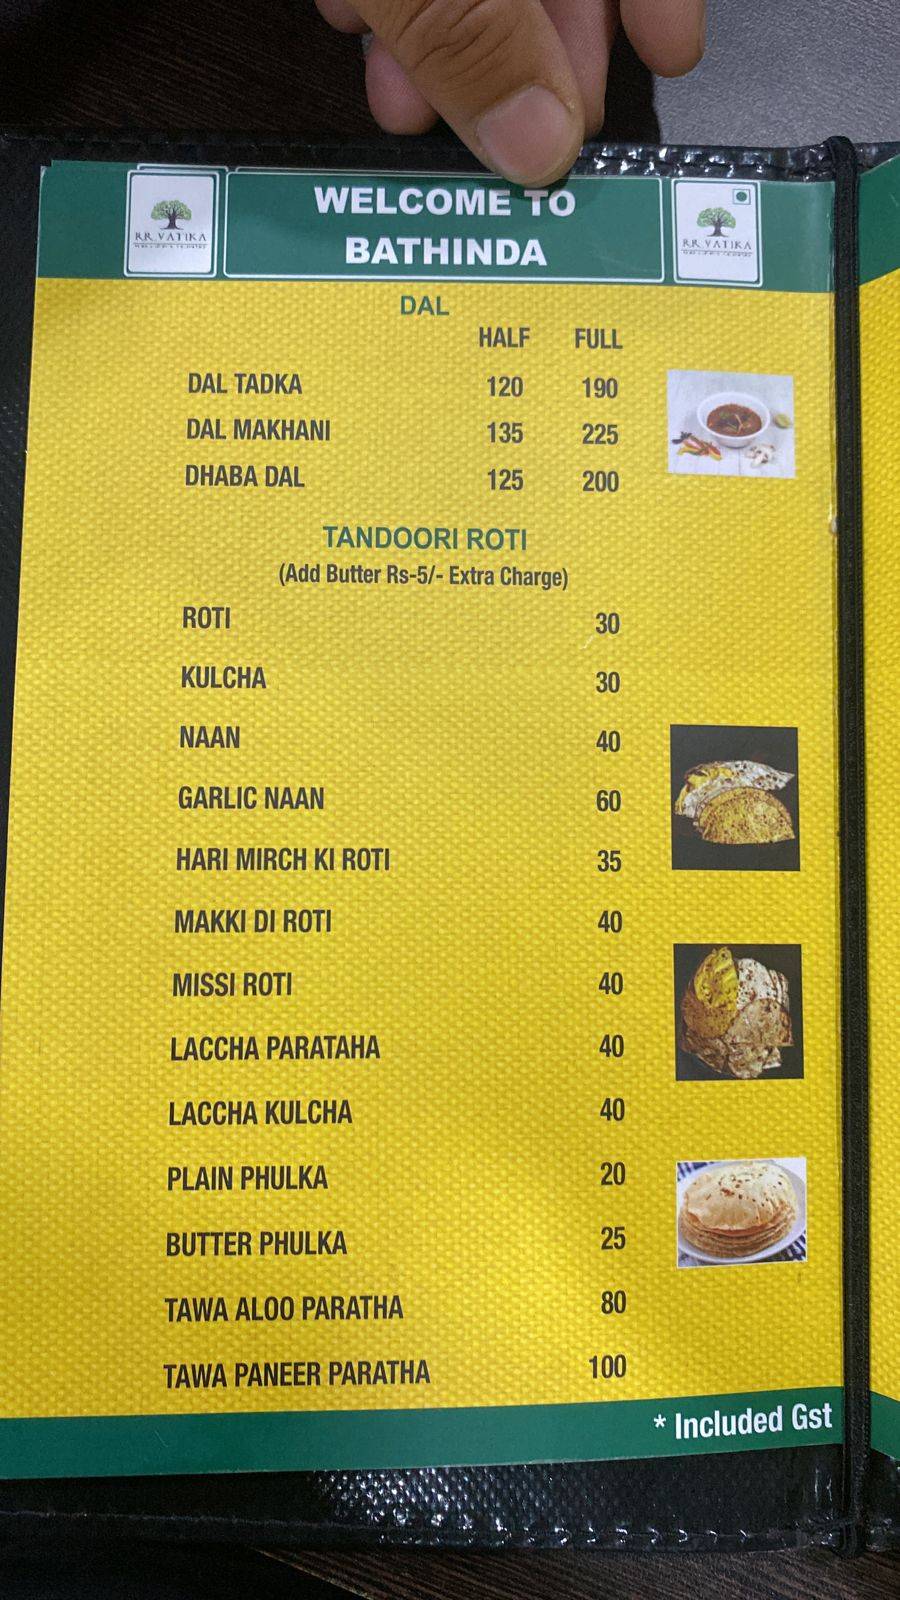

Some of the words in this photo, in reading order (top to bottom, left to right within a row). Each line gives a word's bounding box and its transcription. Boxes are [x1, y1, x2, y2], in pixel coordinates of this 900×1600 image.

[314, 186, 511, 216] WELCOME
[523, 189, 576, 217] TO
[158, 231, 207, 242] VATIKA
[705, 239, 752, 250] VATIKA
[345, 237, 548, 266] BATHINDA
[400, 295, 450, 316] DAL
[479, 326, 530, 348] HALF
[575, 328, 623, 350] FULL
[188, 372, 228, 394] DAL
[234, 373, 303, 395] TADKA
[487, 376, 524, 397] 120
[582, 377, 618, 399] 190
[187, 418, 227, 440] DAL
[233, 418, 331, 441] MAKHANI
[487, 421, 523, 444] 135
[582, 423, 619, 445] 225
[185, 464, 258, 487] DHABA
[265, 465, 305, 488] DAL
[487, 468, 524, 491] 125
[582, 470, 619, 493] 200
[322, 525, 458, 550] TANDOORI
[467, 528, 527, 551] ROTI
[279, 563, 320, 587] (Add
[326, 563, 382, 584] Butter
[387, 564, 443, 585] Rs-5/-
[449, 565, 495, 586] Extra
[500, 566, 568, 591] Charge)
[182, 606, 231, 629] ROTI
[595, 612, 620, 635] 30
[181, 665, 267, 689] KULCHA
[596, 671, 621, 693] 30
[180, 725, 240, 749] NAAN
[596, 730, 621, 753] 40
[178, 786, 257, 810] GARLIC
[264, 786, 324, 810] NAAN
[596, 789, 622, 812] 60
[176, 847, 228, 871] HARI
[236, 847, 307, 871] MIRCH
[314, 847, 335, 871] KI
[342, 847, 390, 871] ROTI
[597, 849, 622, 873] 35
[174, 909, 246, 934] MAKKI
[254, 909, 275, 933] DI
[283, 909, 332, 933] ROTI
[597, 910, 623, 934] 40
[172, 972, 235, 997] MISSI
[243, 972, 292, 997] ROTI
[598, 972, 624, 996] 40
[170, 1036, 260, 1061] LACCHA
[266, 1035, 381, 1060] PARATAHA
[599, 1034, 625, 1058] 40
[169, 1100, 258, 1126] LACCHA
[265, 1099, 353, 1125] KULCHA
[599, 1097, 625, 1122] 40
[167, 1166, 233, 1191] PLAIN
[240, 1165, 329, 1191] PHULKA
[600, 1161, 626, 1186] 20
[166, 1231, 252, 1257] BUTTER
[259, 1230, 348, 1256] PHULKA
[601, 1226, 626, 1250] 25
[164, 1297, 229, 1323] TAWA
[235, 1295, 295, 1322] ALOO
[302, 1295, 404, 1321] PARATHA
[601, 1290, 627, 1315] 80
[163, 1363, 228, 1389] TAWA
[234, 1361, 321, 1388] PANEER
[328, 1359, 431, 1386] PARATHA
[589, 1354, 627, 1379] 100
[675, 1405, 783, 1440] Included
[791, 1402, 833, 1430] Gst
